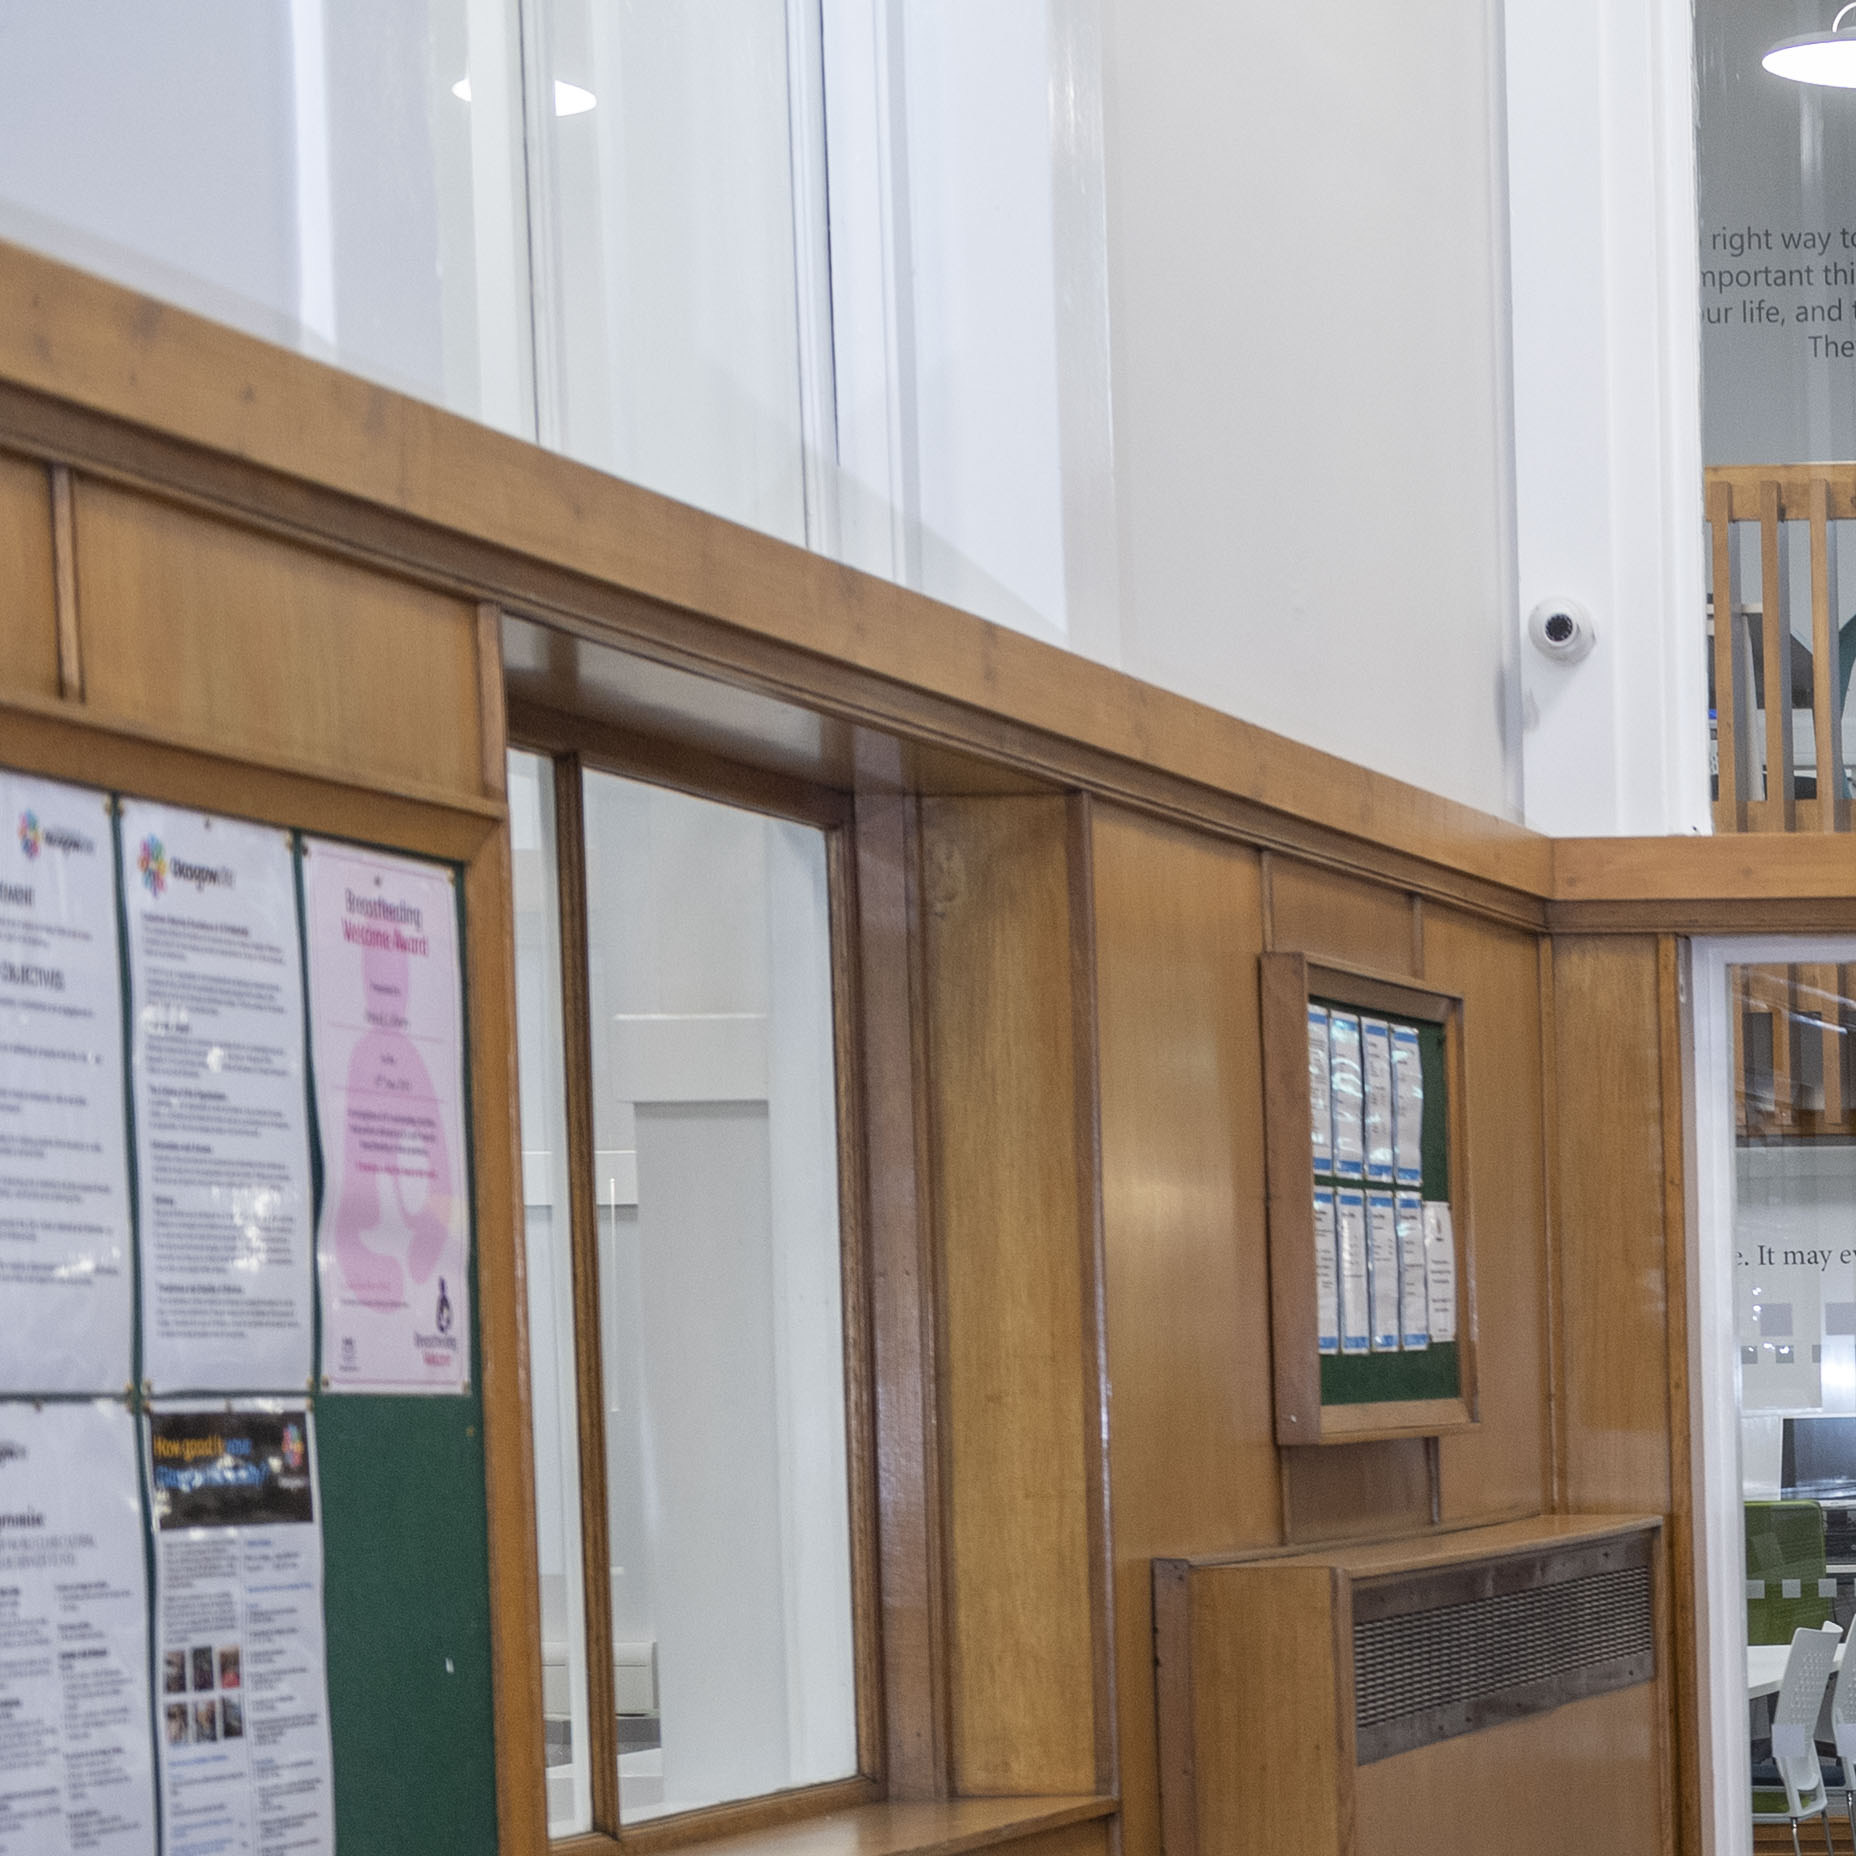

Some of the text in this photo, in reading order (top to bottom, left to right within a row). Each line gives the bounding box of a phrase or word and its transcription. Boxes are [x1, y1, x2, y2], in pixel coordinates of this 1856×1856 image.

[1712, 225, 1773, 257] right
[1781, 231, 1832, 256] way
[1743, 299, 1786, 327] life,
[1795, 298, 1843, 323] and
[1757, 1244, 1777, 1266] It
[1783, 1249, 1832, 1272] may
